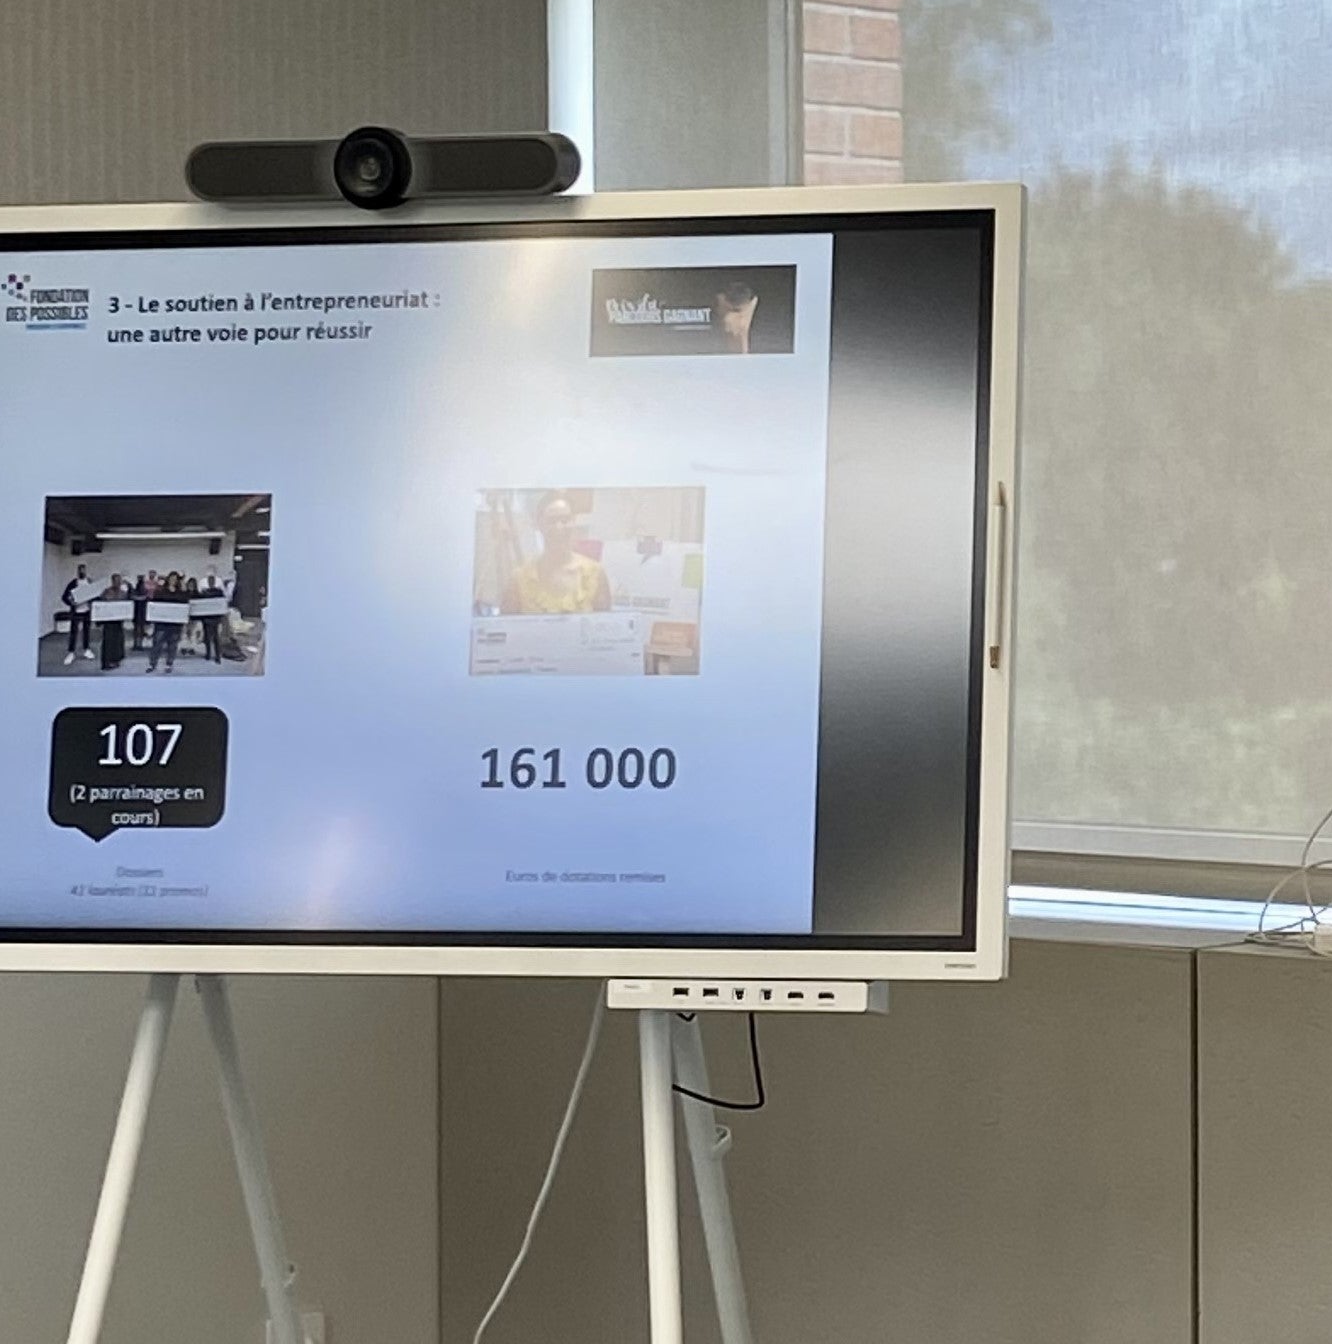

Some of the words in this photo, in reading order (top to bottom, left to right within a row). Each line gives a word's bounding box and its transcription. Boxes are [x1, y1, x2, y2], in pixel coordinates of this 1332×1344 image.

[108, 297, 119, 313] 3
[138, 296, 160, 313] Le
[165, 293, 238, 312] soutien
[244, 292, 254, 311] à
[6, 306, 27, 322] DES
[107, 329, 144, 343] une
[150, 326, 202, 343] autre
[207, 323, 249, 342] voie
[254, 326, 302, 345] pour
[307, 321, 373, 341] réussir
[98, 723, 183, 766] 107
[480, 747, 567, 789] 161
[585, 747, 677, 789] 000
[70, 784, 86, 803] (2
[90, 784, 180, 803] parrainages
[184, 788, 204, 800] en
[111, 808, 160, 826] cours)
